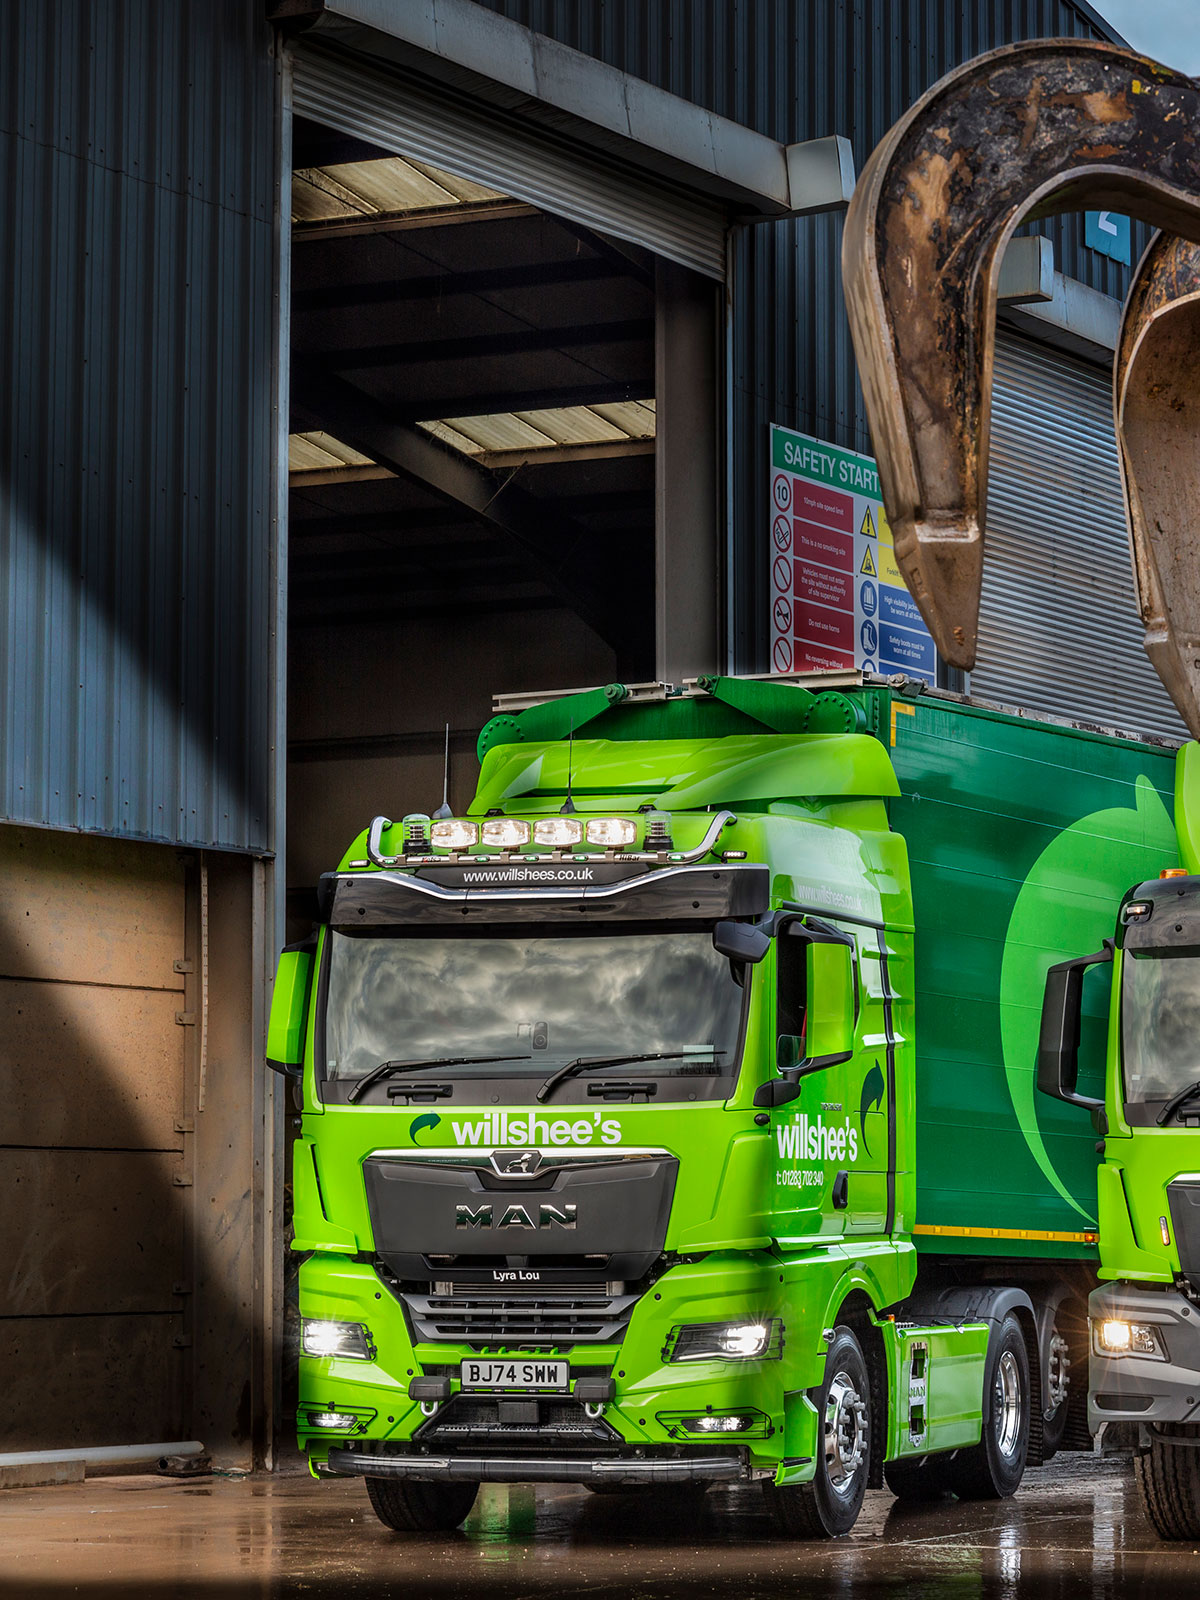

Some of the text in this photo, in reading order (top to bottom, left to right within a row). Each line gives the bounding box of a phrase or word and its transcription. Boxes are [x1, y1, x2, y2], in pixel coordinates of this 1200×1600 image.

[784, 441, 881, 493] SAFETY START
[777, 485, 788, 501] 10
[801, 535, 809, 545] This
[823, 544, 838, 555] smoking
[463, 867, 593, 882] www.willshees.co.uk
[451, 1112, 622, 1145] willshee's
[777, 1113, 857, 1161] willshee's
[456, 1204, 577, 1230] MAN
[493, 1270, 540, 1281] Lyra Lou
[469, 1365, 557, 1382] BJ74 SWW
